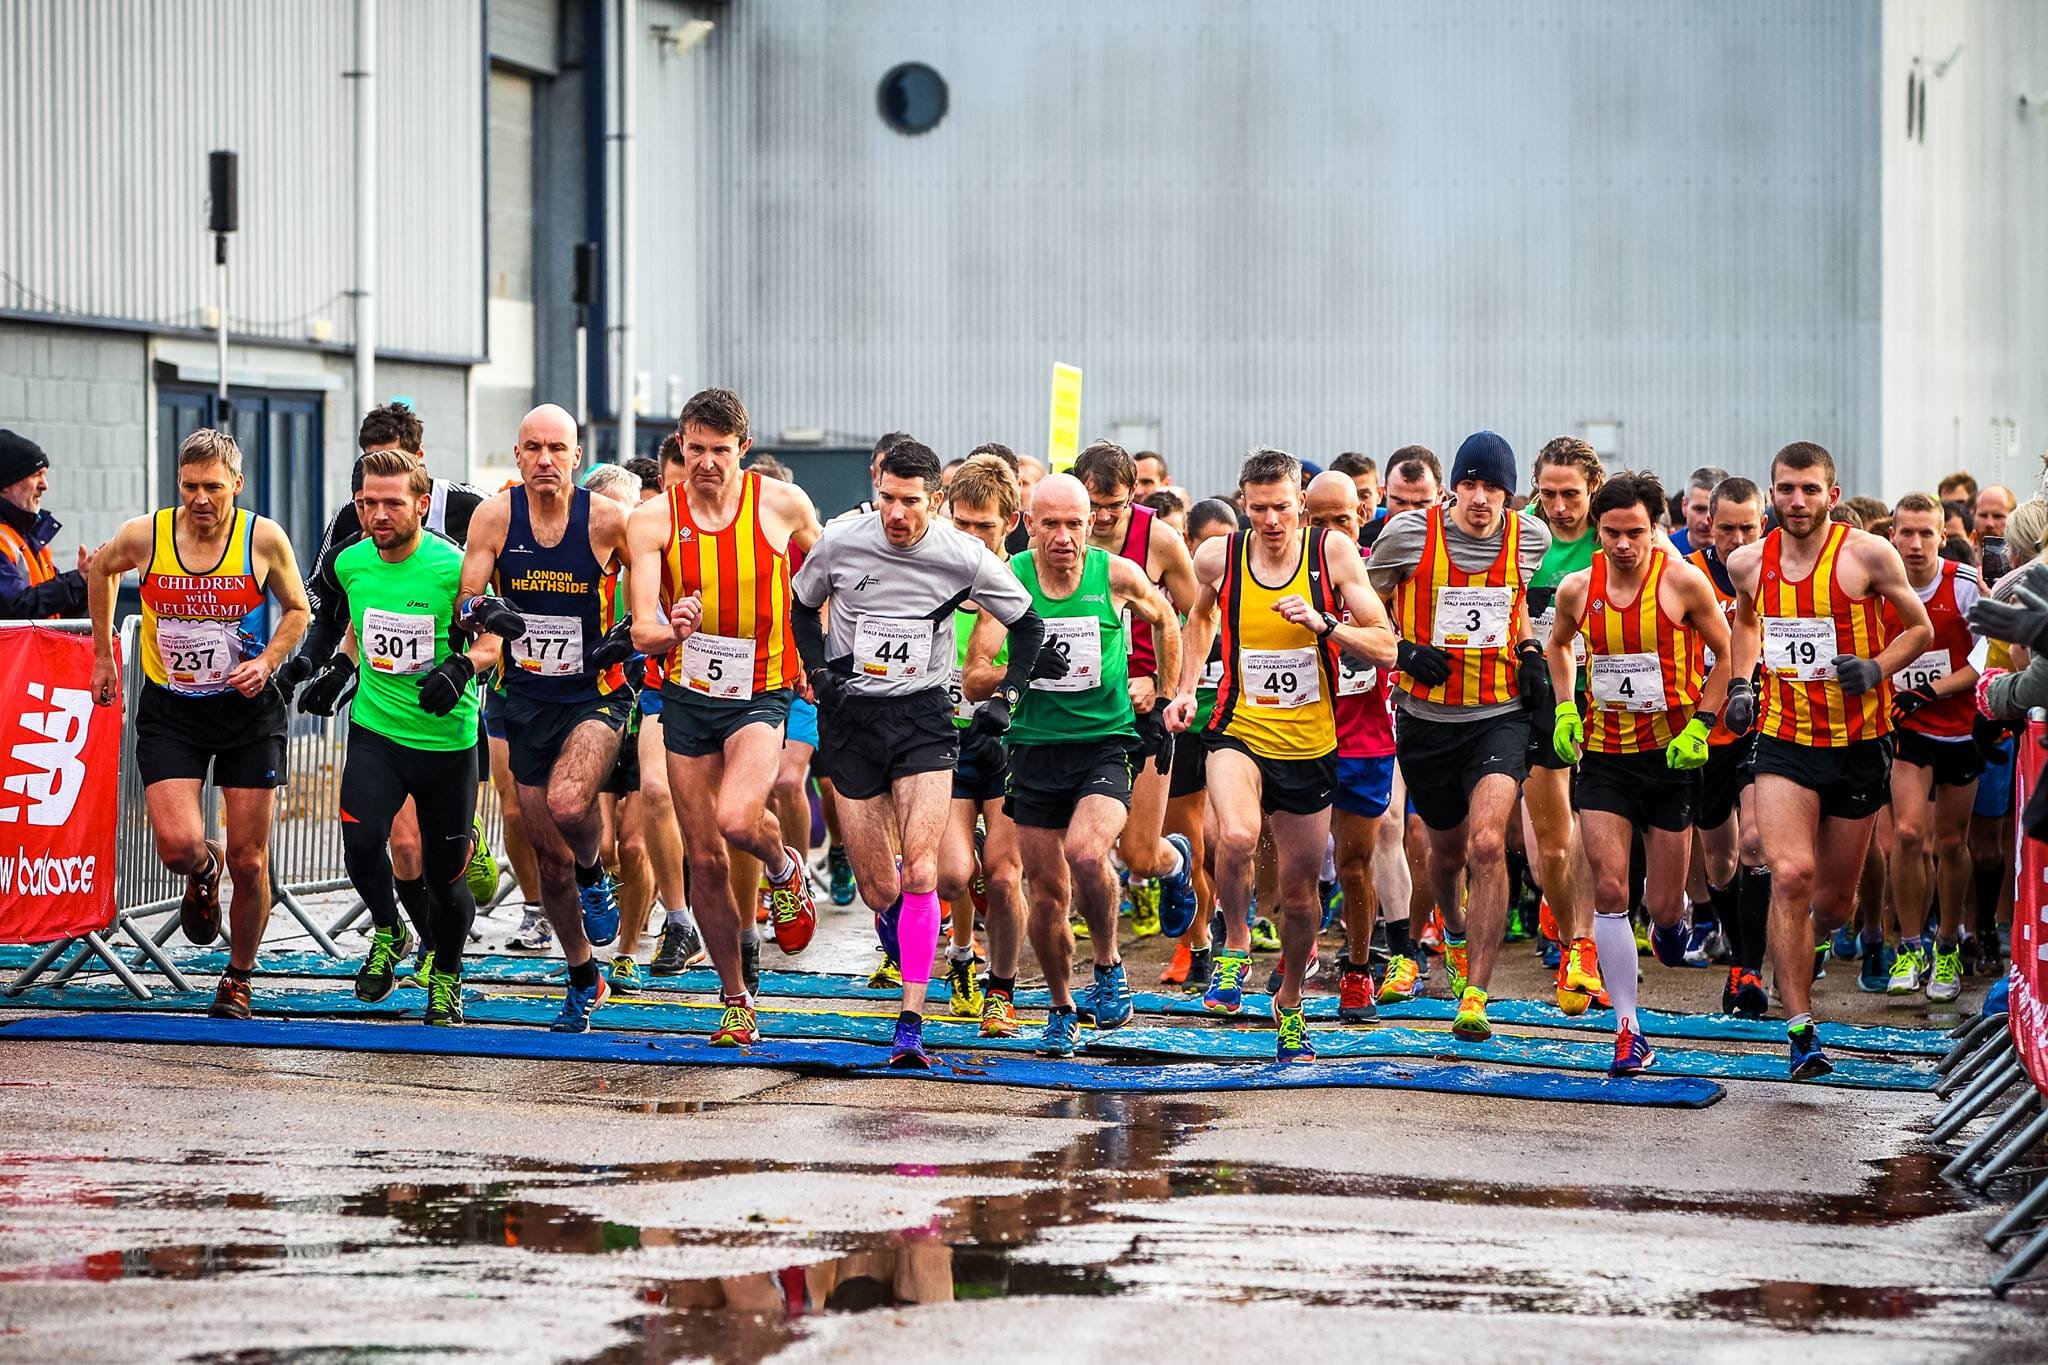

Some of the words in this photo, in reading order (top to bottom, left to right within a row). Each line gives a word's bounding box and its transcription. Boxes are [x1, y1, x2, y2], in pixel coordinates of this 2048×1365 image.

[158, 576, 246, 590] CHILDREN
[512, 579, 588, 593] HEATHSIDE
[527, 570, 572, 582] LONDON
[185, 591, 216, 603] with
[155, 601, 248, 616] LEUKAEMIA
[1466, 610, 1480, 631] 3
[374, 634, 417, 659] 301
[522, 637, 568, 659] 177
[701, 648, 733, 657] MARATHON
[875, 641, 909, 663] 44
[1786, 642, 1815, 664] 19
[170, 649, 215, 671] 237
[708, 659, 722, 681] 5
[1264, 672, 1297, 693] 49
[1620, 677, 1634, 698] 4
[1903, 670, 1941, 688] 196
